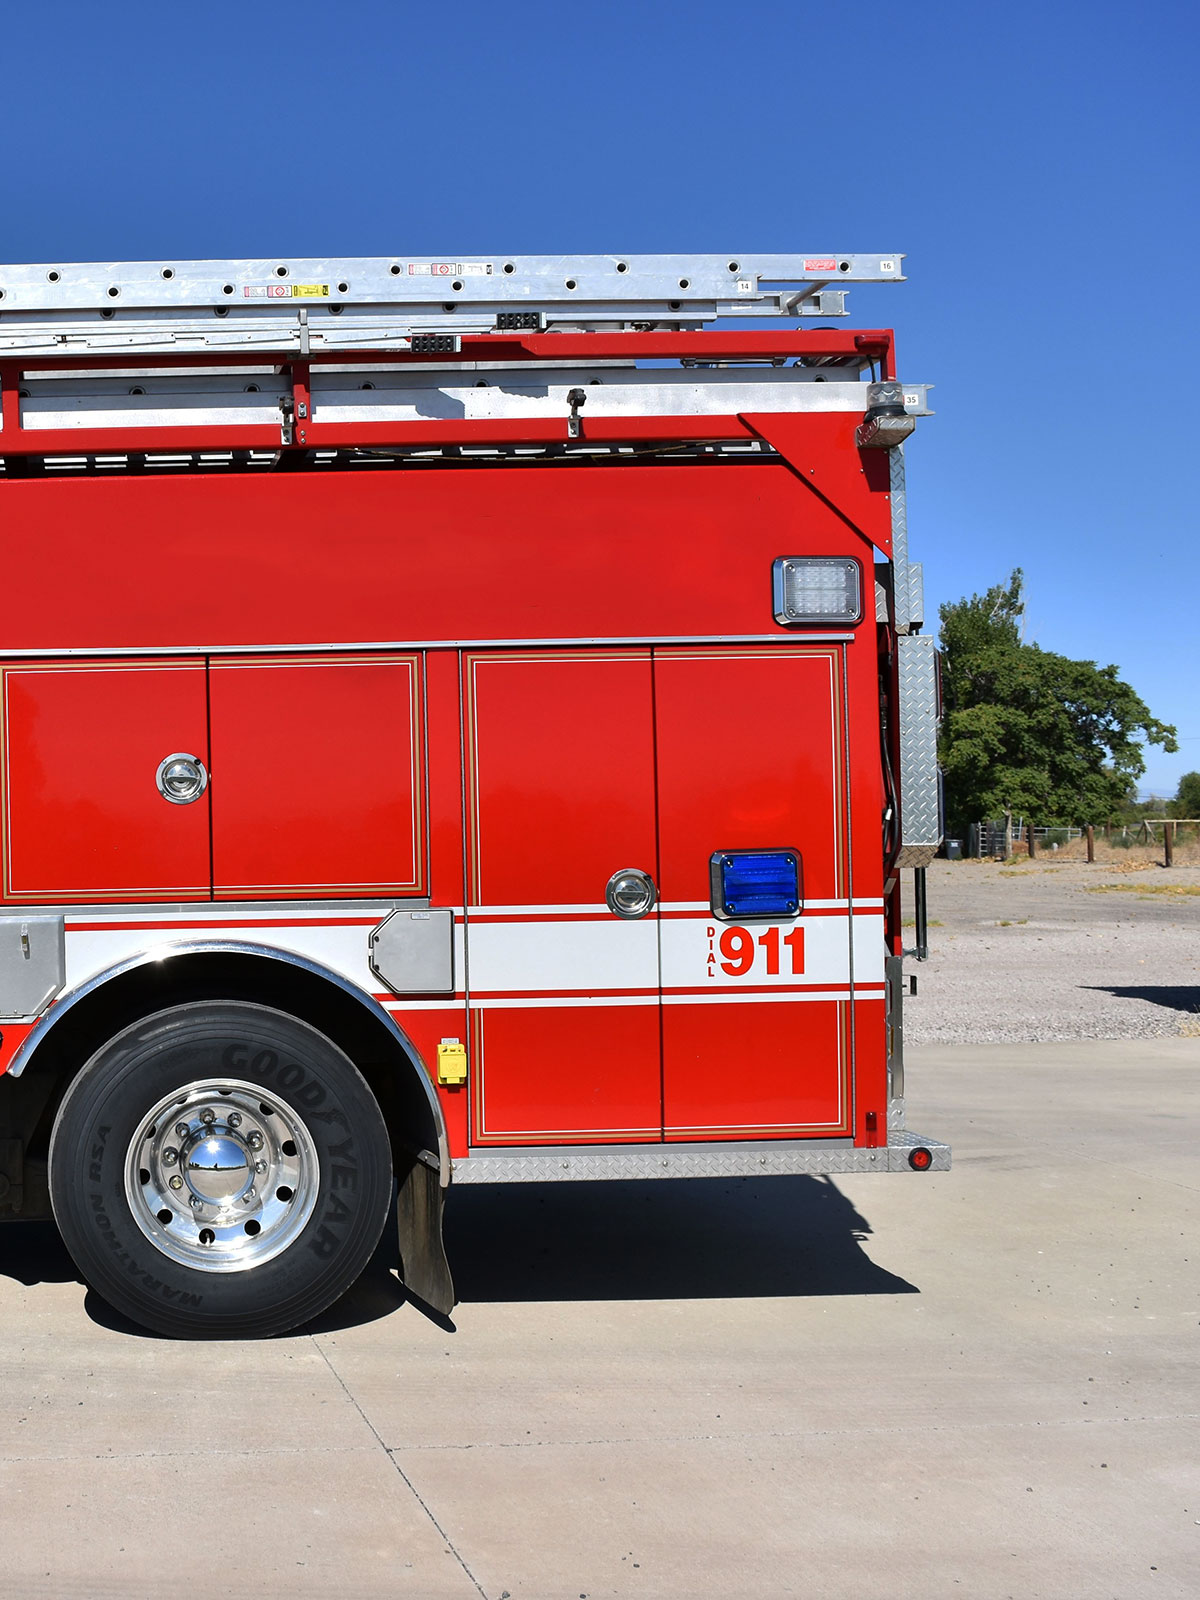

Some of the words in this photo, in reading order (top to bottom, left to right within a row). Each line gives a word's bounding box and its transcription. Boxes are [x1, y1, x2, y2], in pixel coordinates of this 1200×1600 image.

[882, 262, 892, 270] 16
[906, 396, 917, 404] 35
[706, 926, 716, 977] DIAL
[719, 925, 805, 977] 911
[90, 1125, 112, 1183] RSA
[222, 1043, 358, 1260] GOODYEAR
[90, 1194, 203, 1307] MARATHON
